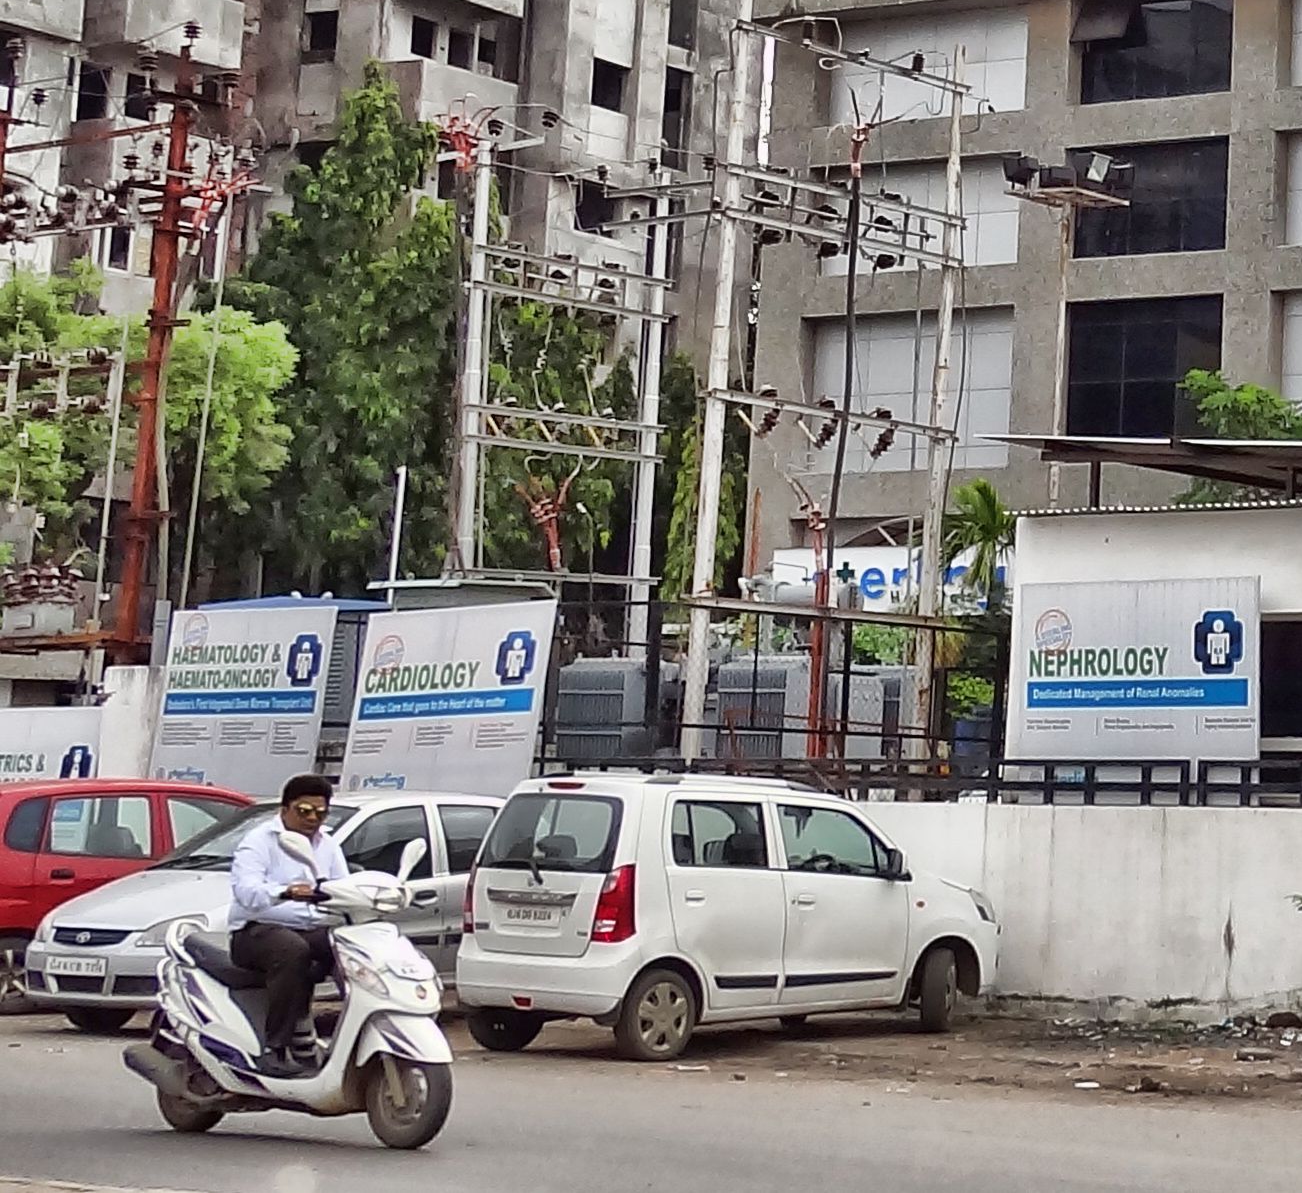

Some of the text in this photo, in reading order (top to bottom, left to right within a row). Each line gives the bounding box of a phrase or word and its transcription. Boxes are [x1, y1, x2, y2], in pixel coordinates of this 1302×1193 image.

[172, 643, 282, 665] HAEMATOLOGY &
[1029, 647, 1169, 677] NEPHROLOGY
[365, 661, 481, 694] CARDIOLOGY
[1074, 688, 1125, 701] Management
[1126, 687, 1135, 698] of
